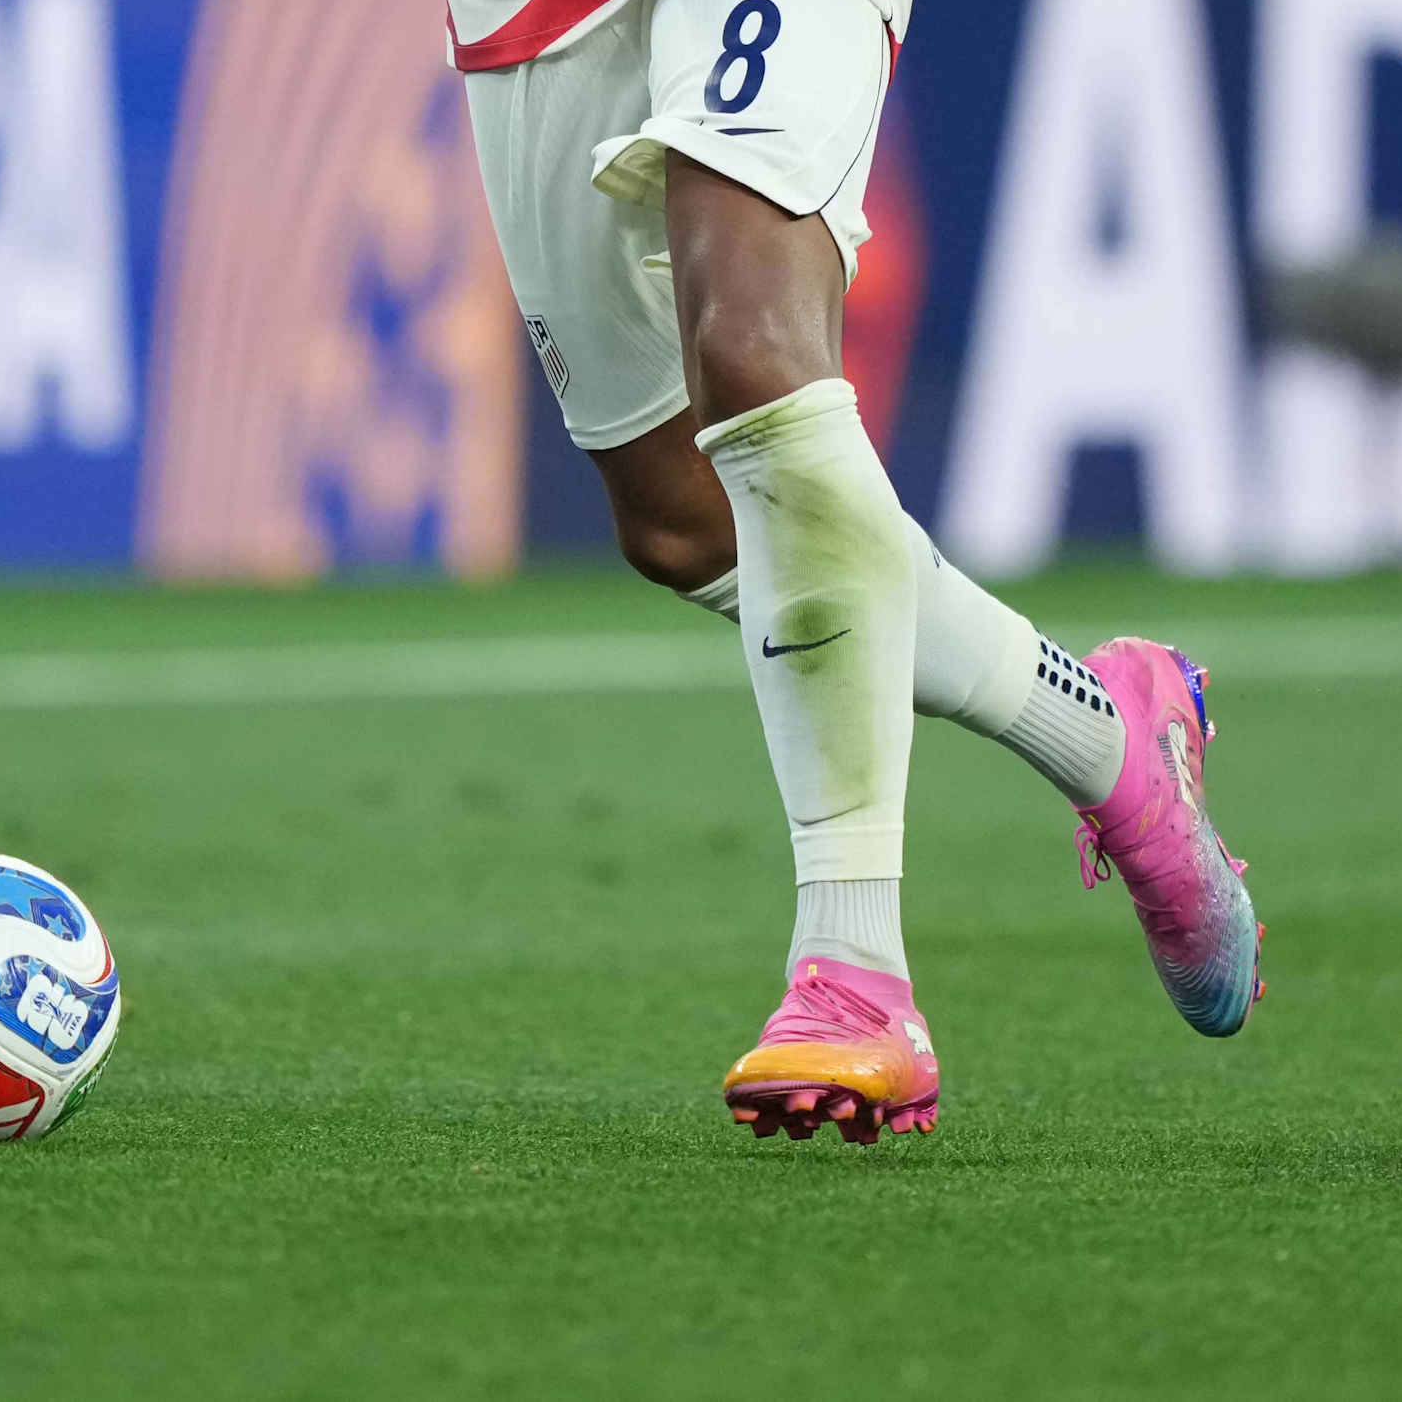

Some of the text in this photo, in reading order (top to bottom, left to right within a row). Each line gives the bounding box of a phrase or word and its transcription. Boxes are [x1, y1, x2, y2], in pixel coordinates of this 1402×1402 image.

[526, 320, 549, 349] SA
[1156, 733, 1179, 780] FUTURE
[67, 1015, 83, 1038] FIFA
